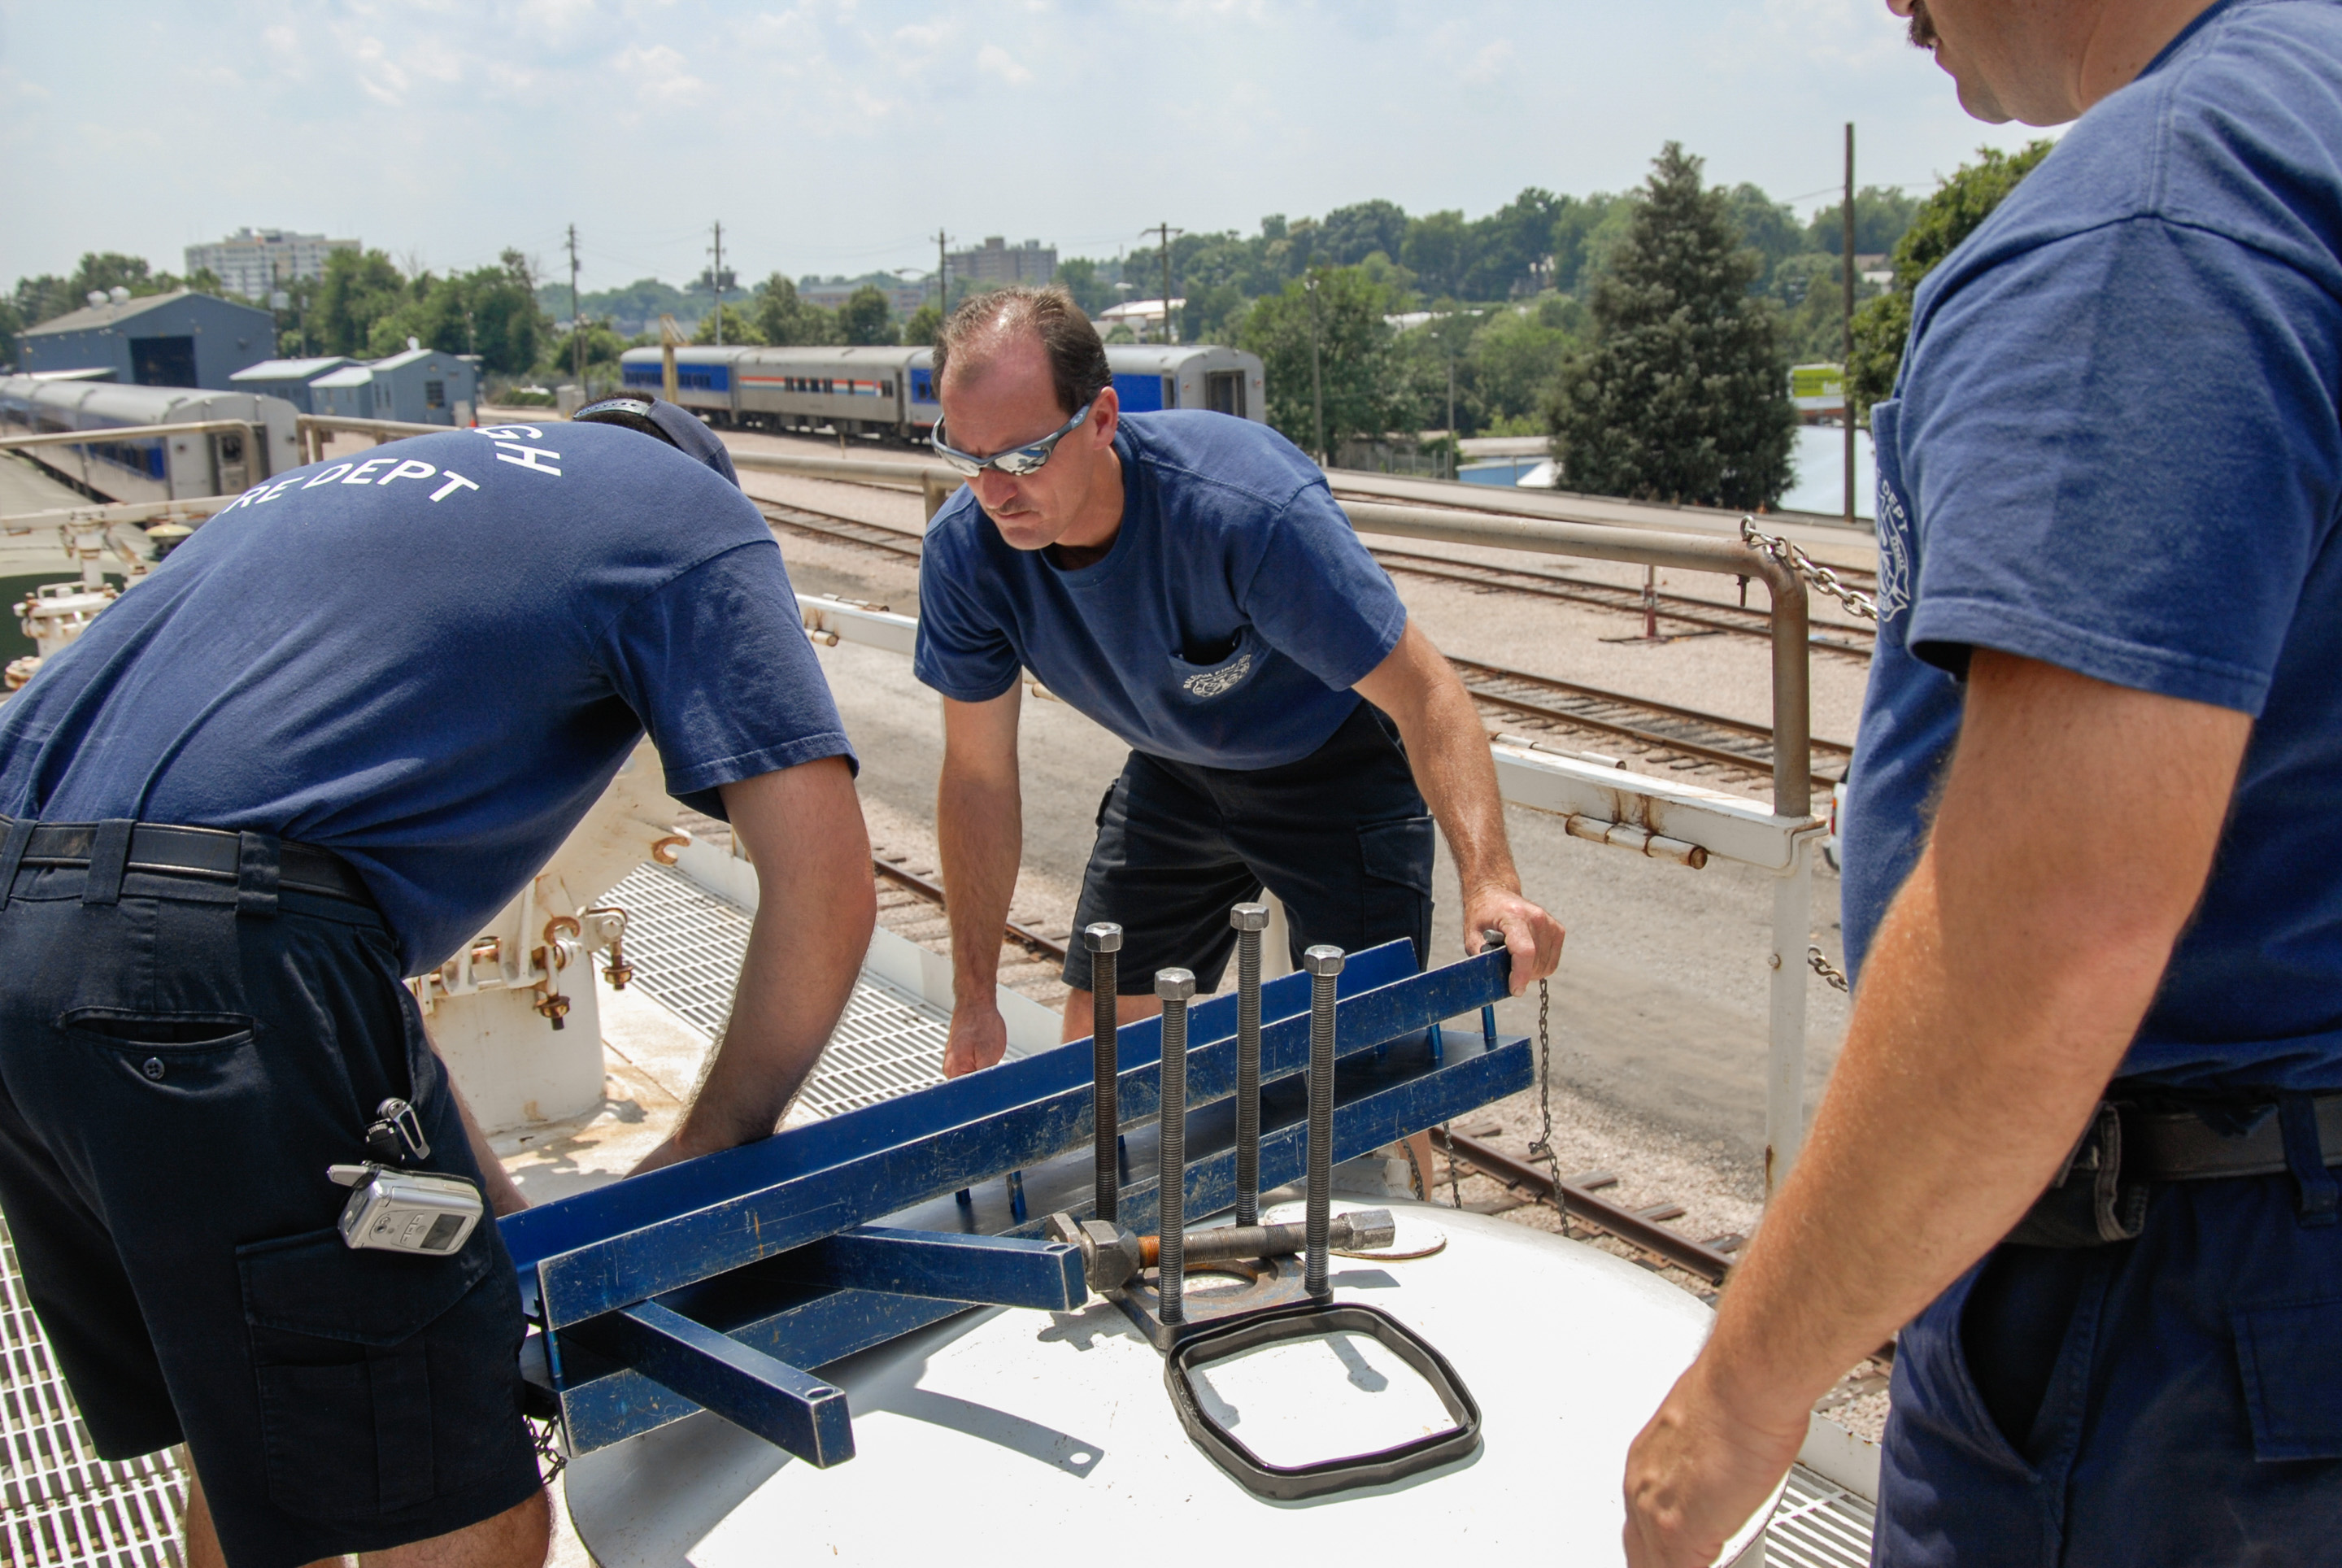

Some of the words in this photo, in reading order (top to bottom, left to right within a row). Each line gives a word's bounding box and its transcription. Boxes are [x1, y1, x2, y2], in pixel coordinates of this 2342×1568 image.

[211, 476, 306, 519] RE
[301, 458, 481, 503] DEPT
[1881, 479, 1909, 533] DEPT
